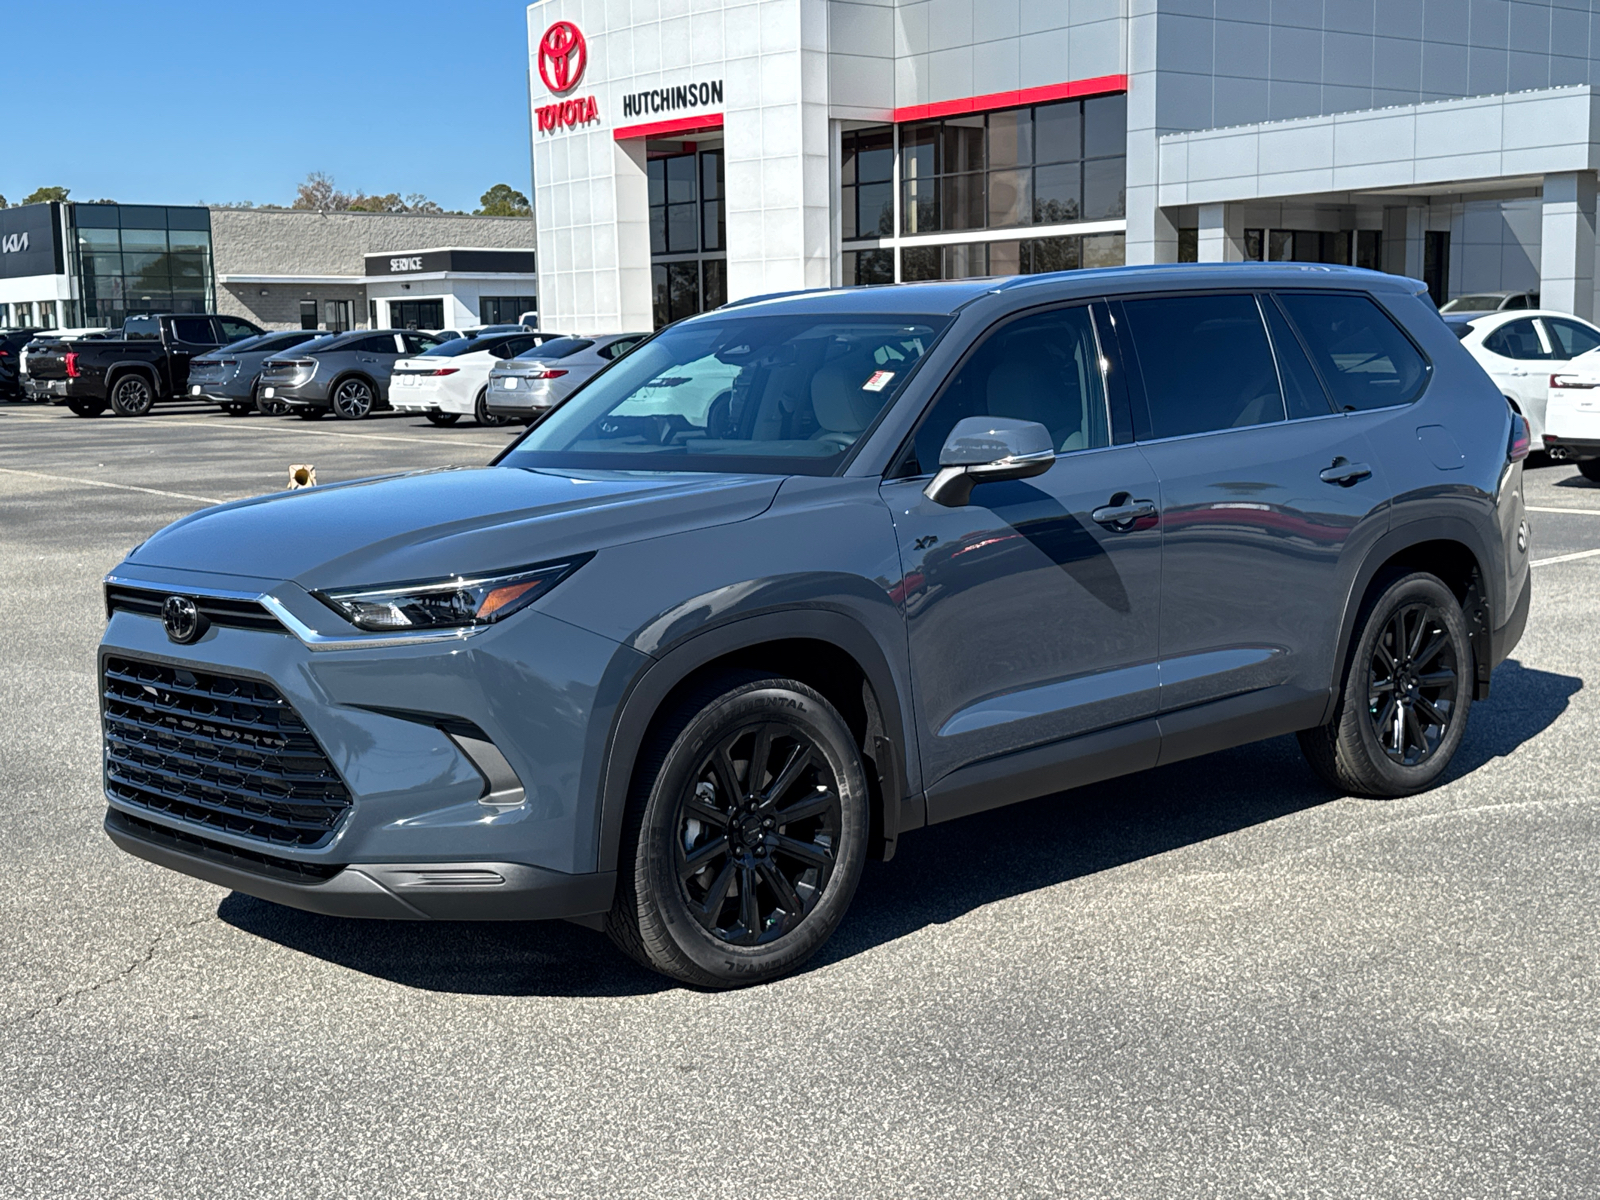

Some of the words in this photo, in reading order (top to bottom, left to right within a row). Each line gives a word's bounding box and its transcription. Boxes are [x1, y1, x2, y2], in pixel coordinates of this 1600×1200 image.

[535, 95, 599, 133] TOYOTA
[623, 80, 724, 118] HUTCHINSON
[2, 231, 29, 254] KIA
[390, 256, 423, 272] SERVICE
